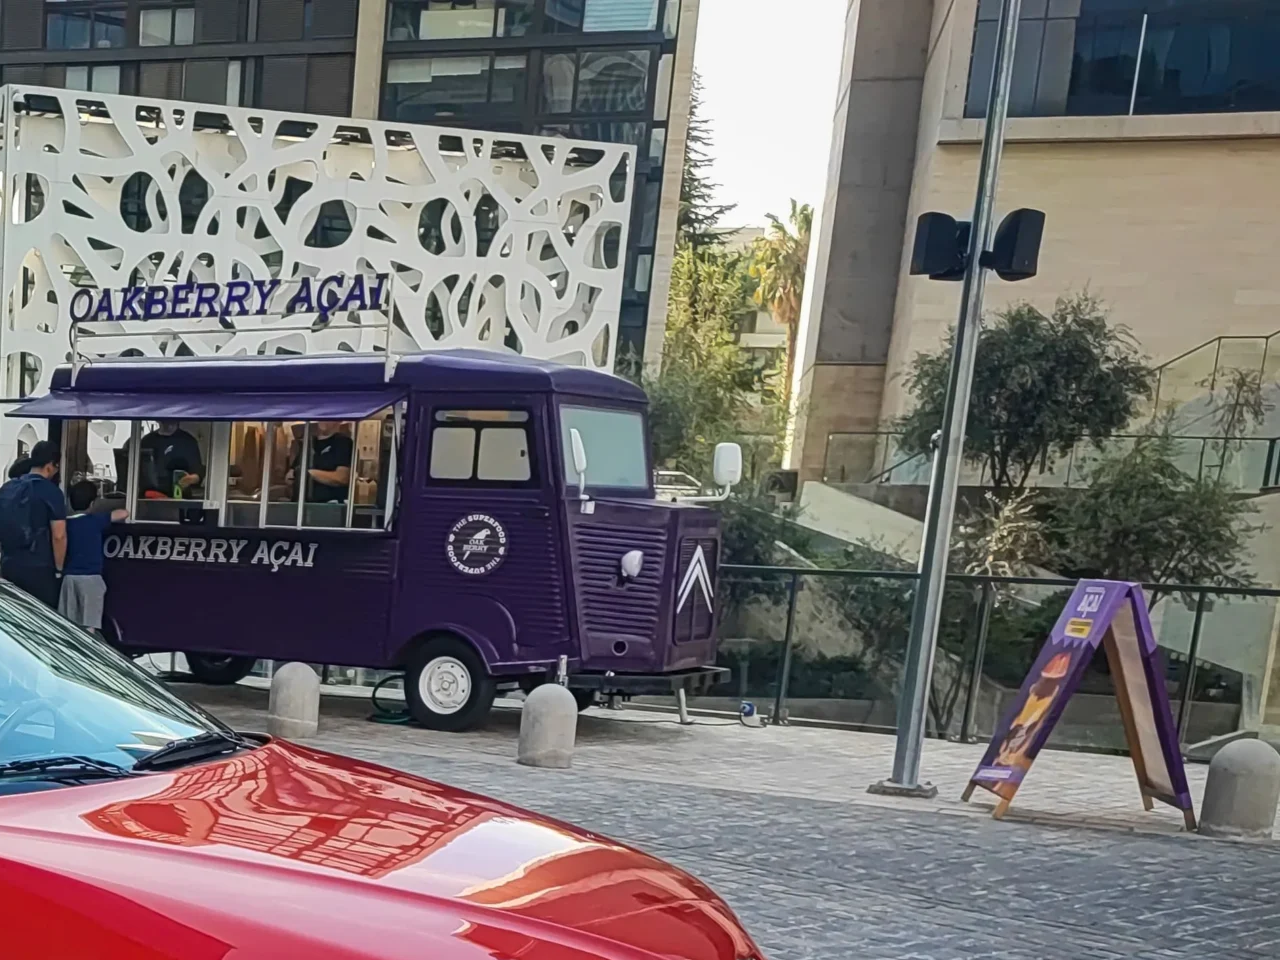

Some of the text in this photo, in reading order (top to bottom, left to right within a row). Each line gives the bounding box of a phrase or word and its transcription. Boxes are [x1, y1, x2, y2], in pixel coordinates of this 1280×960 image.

[70, 273, 389, 322] OAKBERRY AÇAI
[452, 514, 506, 544] THE SUPERFOOD
[103, 535, 319, 572] OAKBERRY AÇAI
[447, 545, 485, 574] SUPERFOOD
